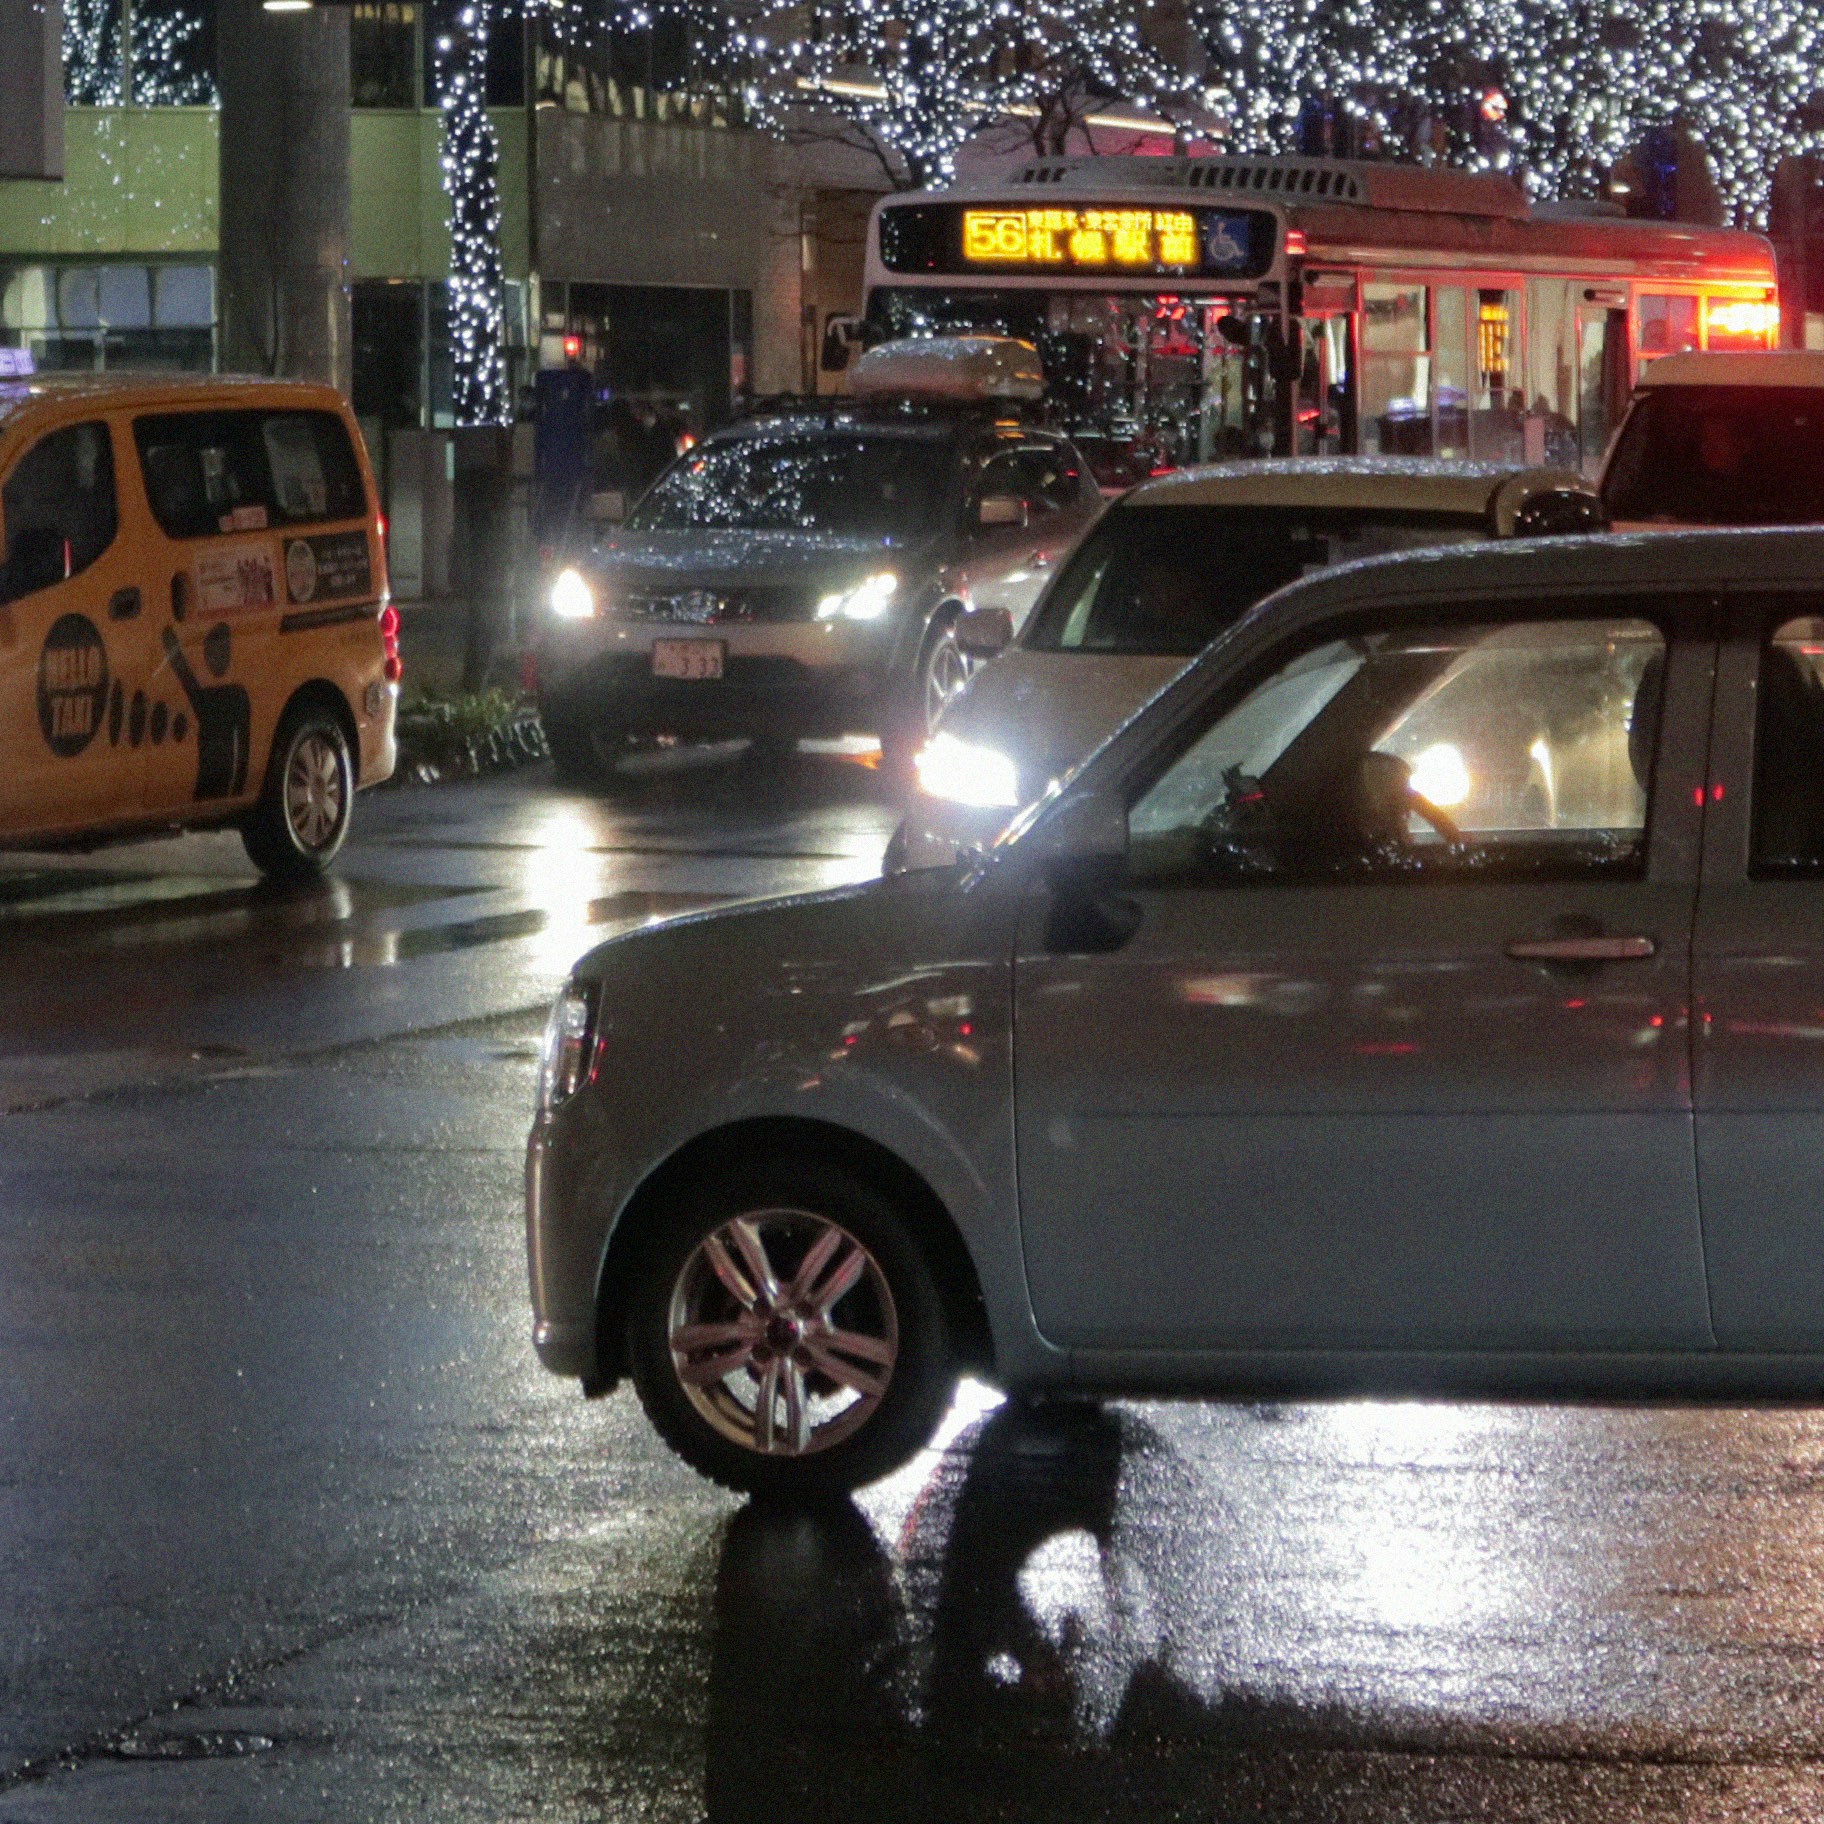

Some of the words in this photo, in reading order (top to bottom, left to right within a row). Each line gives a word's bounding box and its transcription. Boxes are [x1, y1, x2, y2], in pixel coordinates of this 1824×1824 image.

[970, 218, 1023, 255] 56
[44, 646, 102, 690] HELLO
[49, 695, 93, 737] TAXI
